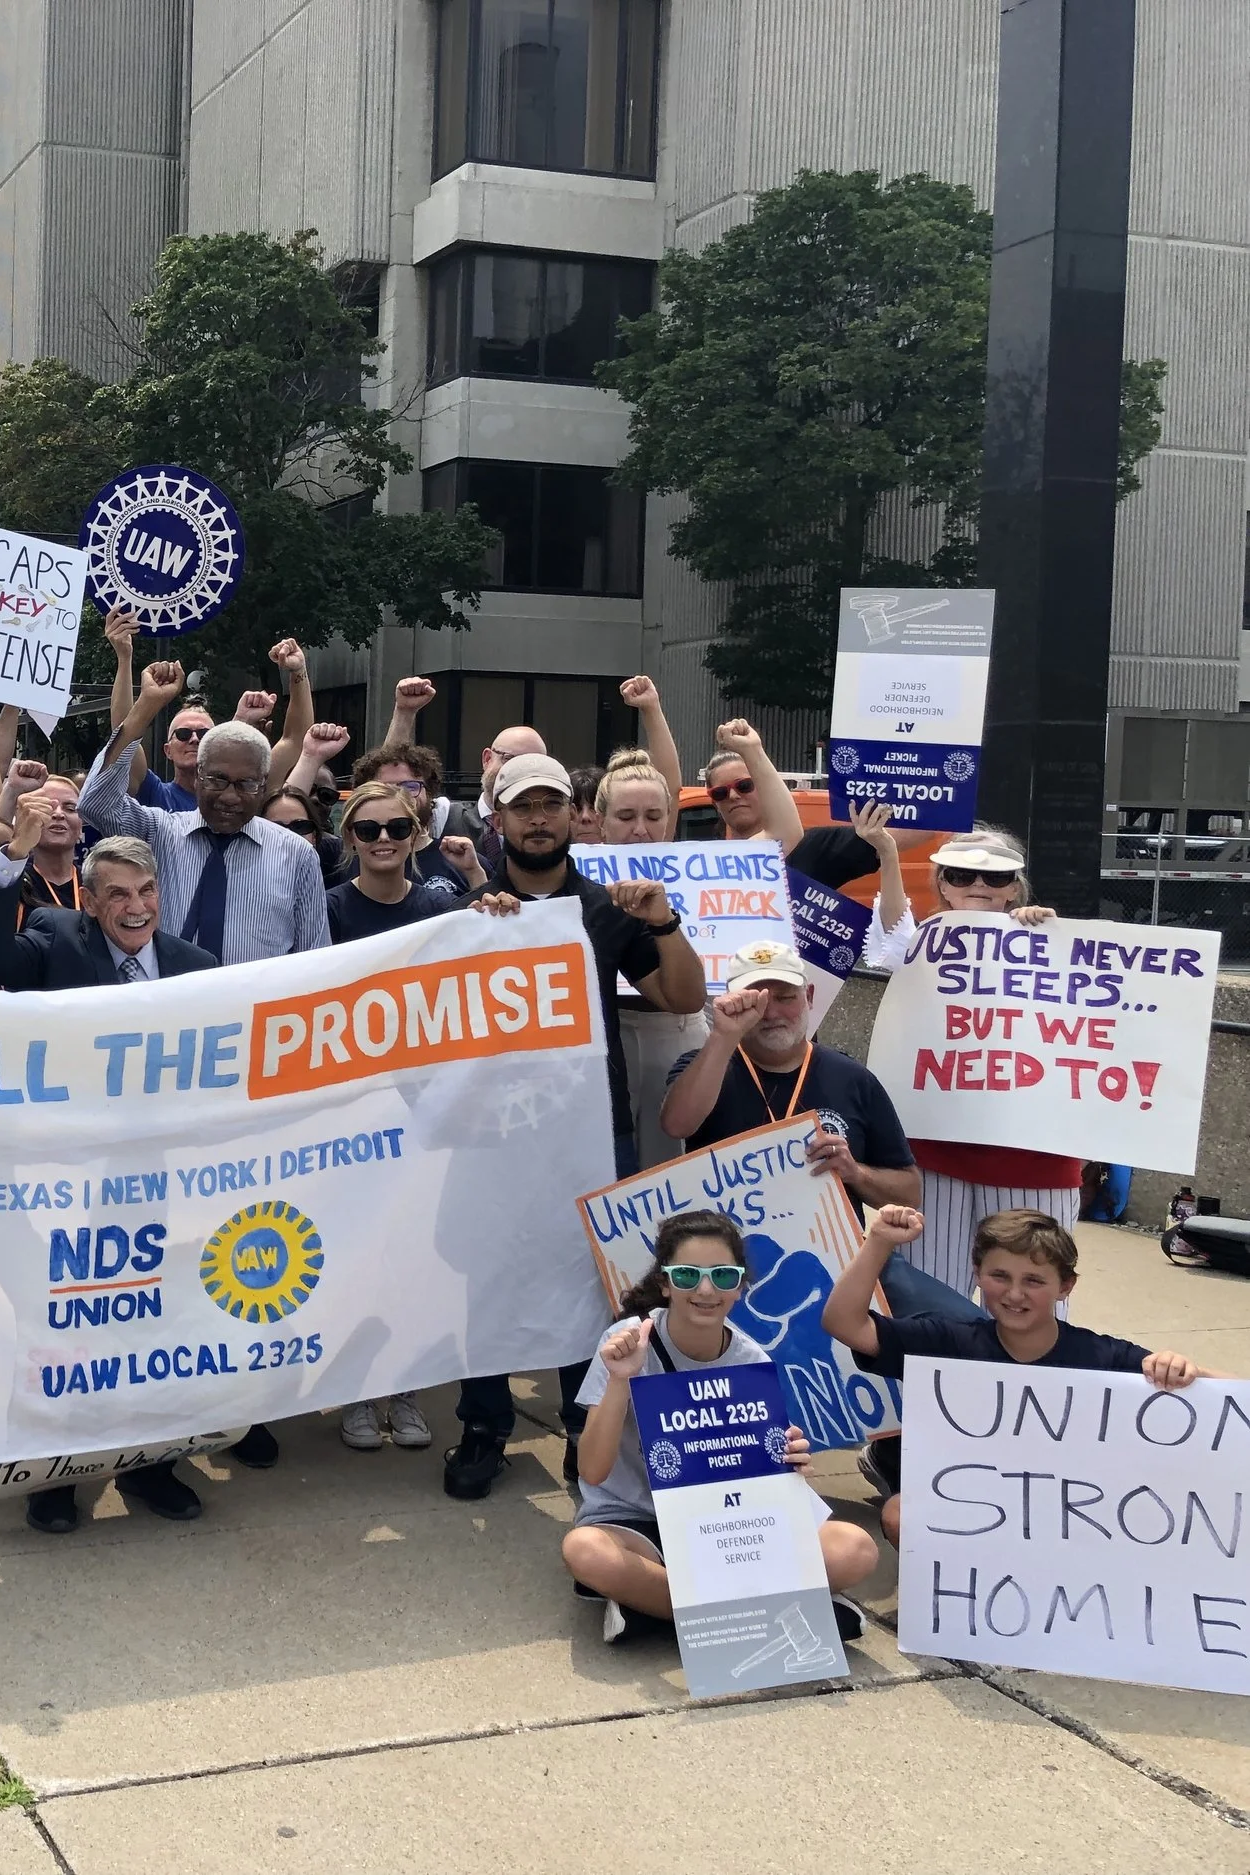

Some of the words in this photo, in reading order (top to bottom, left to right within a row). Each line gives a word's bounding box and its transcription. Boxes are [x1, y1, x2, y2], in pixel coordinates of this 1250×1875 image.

[146, 497, 160, 505] AND
[123, 527, 194, 579] UAW
[55, 607, 77, 630] TO
[885, 694, 931, 703] DEFENDER
[891, 682, 926, 691] SERVICE
[870, 705, 944, 716] NEIGHBORHOOD
[896, 722, 915, 733] AT
[884, 752, 918, 762] PICKET
[864, 763, 938, 777] INFORMATIONAL
[846, 780, 887, 797] 2325
[893, 784, 954, 802] LOCAL
[889, 803, 917, 820] UA
[577, 855, 620, 885] EN
[628, 855, 681, 883] NDS
[685, 853, 781, 882] CLIENTS
[698, 888, 784, 918] ATTACK
[804, 886, 840, 912] UAW
[790, 899, 815, 923] CAL
[817, 915, 854, 940] 2325
[794, 924, 830, 948] MATIONAL
[904, 917, 1049, 967] JUSTICE
[1070, 938, 1204, 978] NEVER
[937, 964, 1158, 1014] SLEEPS...
[94, 1022, 243, 1097] THE
[261, 961, 575, 1078] PROMISE
[946, 1005, 1023, 1040] BUT
[1035, 1011, 1116, 1051] WE
[913, 1048, 1045, 1092] NEED
[1055, 1057, 1162, 1111] TO!
[101, 1171, 168, 1206] NEW
[176, 1160, 257, 1198] YORK
[280, 1127, 405, 1180] DETROIT
[583, 1178, 693, 1243] UNTIL
[49, 1221, 167, 1282] NDS
[236, 1244, 278, 1272] UAW
[48, 1287, 162, 1330] UNION
[42, 1356, 121, 1398] UAW
[128, 1343, 238, 1385] LOCAL
[247, 1333, 324, 1371] 2325
[688, 1377, 731, 1402] UAW
[659, 1408, 726, 1433] LOCAL
[727, 1400, 769, 1425] 2325
[934, 1368, 1250, 1451] UNION
[683, 1434, 759, 1454] INFORMATIONAL
[1, 1460, 31, 1485] To
[708, 1453, 743, 1469] PICKET
[723, 1492, 743, 1508] AT
[926, 1463, 1243, 1559] STRON
[699, 1516, 776, 1535] NEIGHBORHOOD
[716, 1534, 765, 1550] DEFENDER
[724, 1550, 762, 1565] SERVICE
